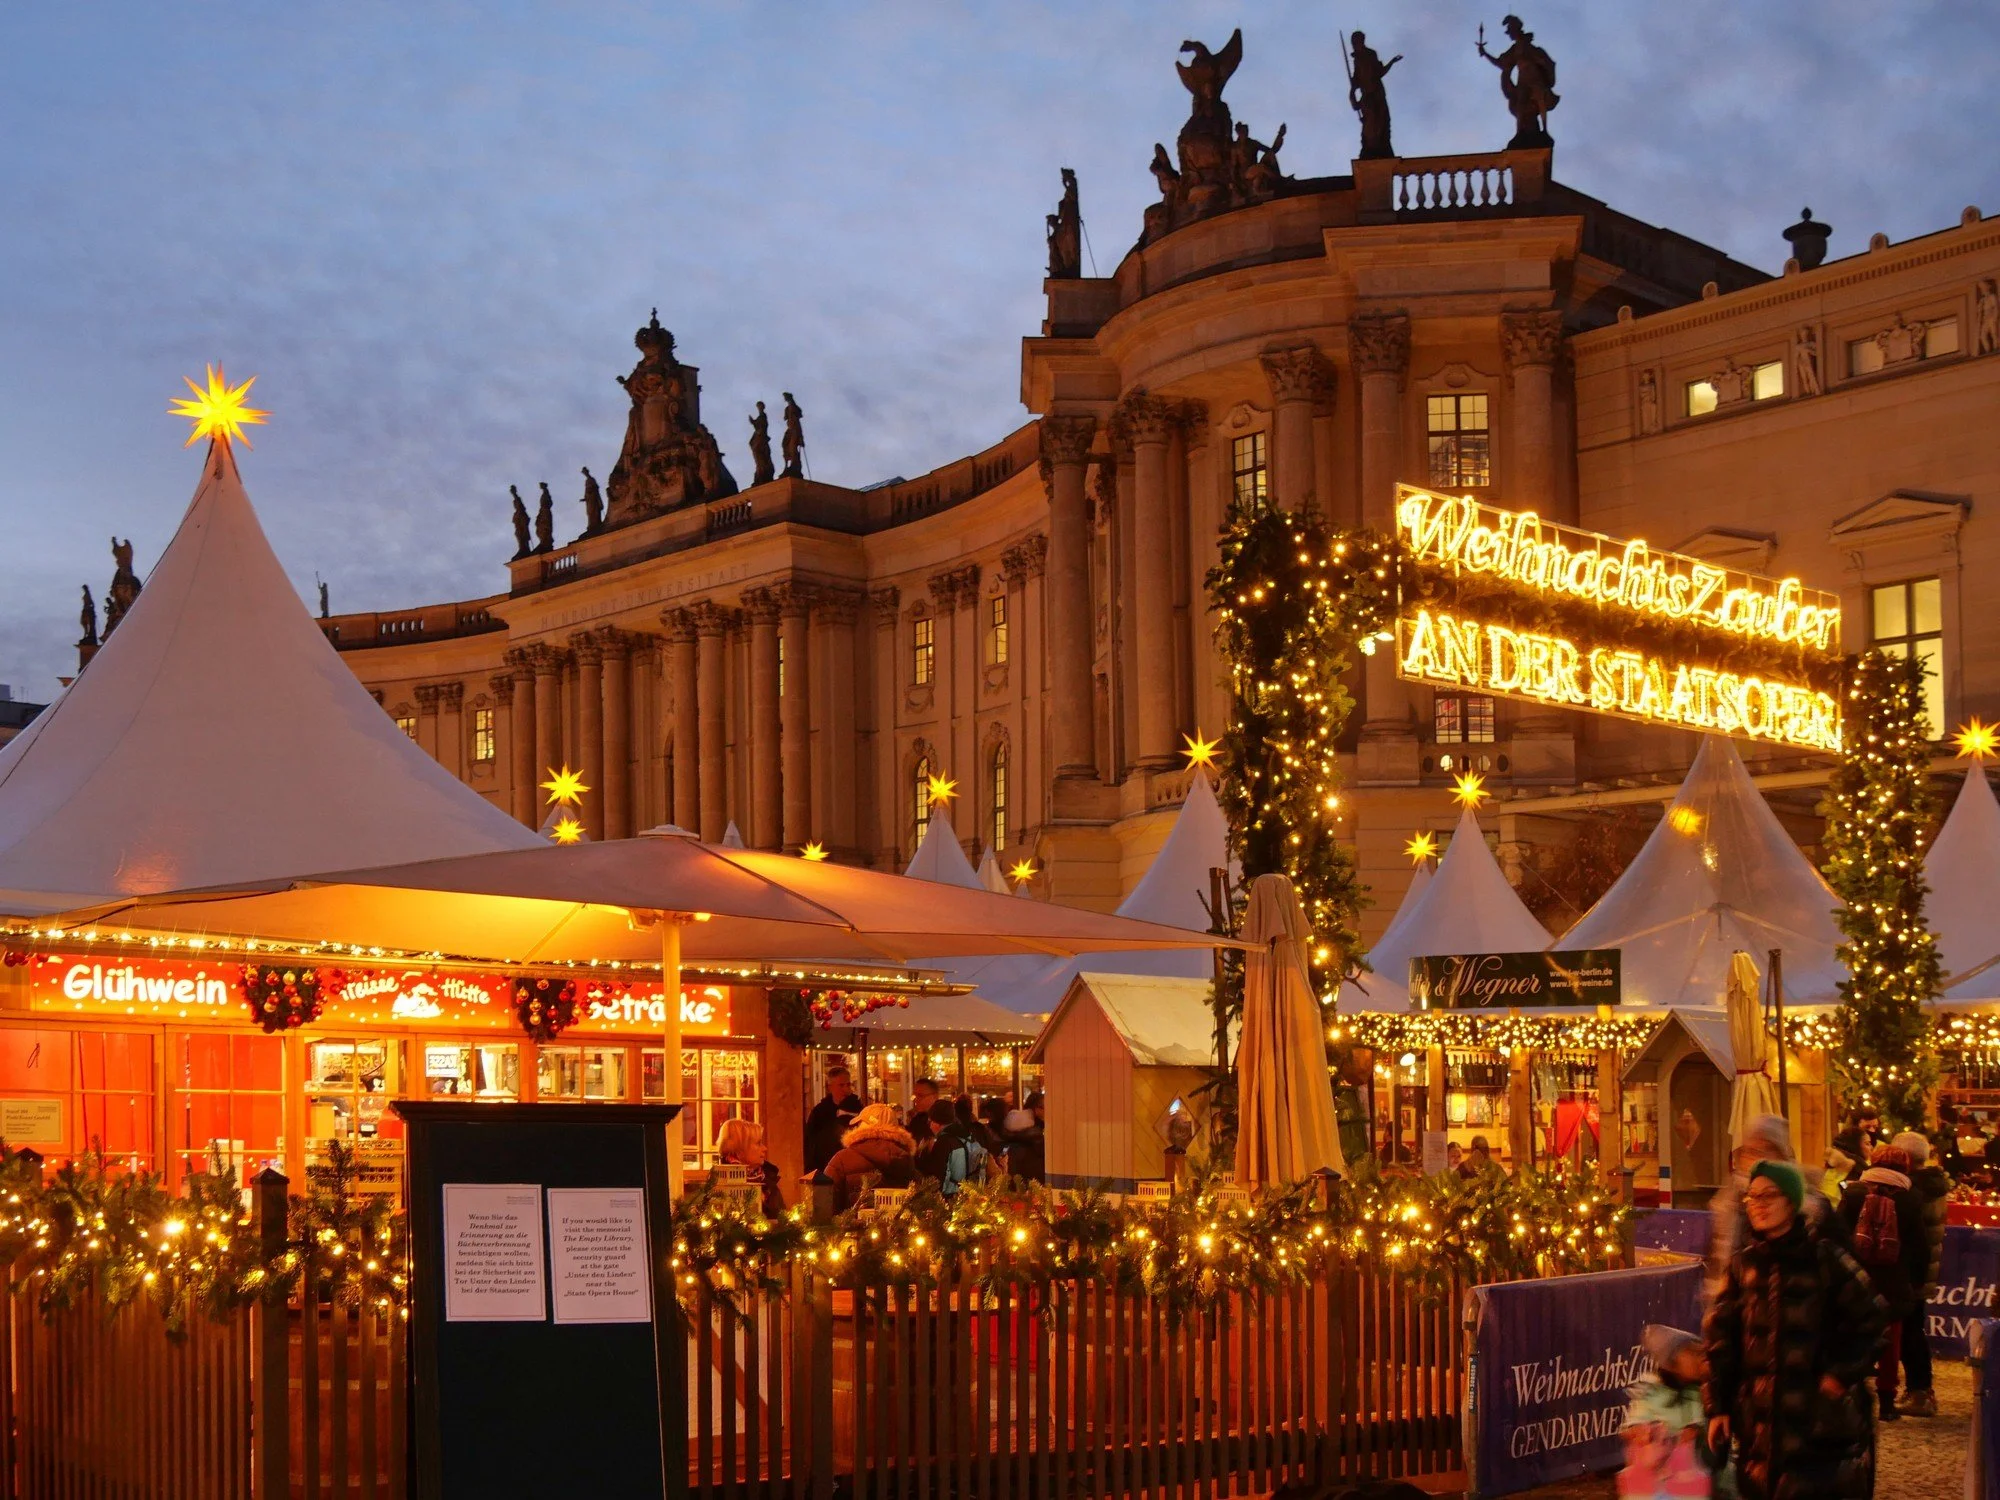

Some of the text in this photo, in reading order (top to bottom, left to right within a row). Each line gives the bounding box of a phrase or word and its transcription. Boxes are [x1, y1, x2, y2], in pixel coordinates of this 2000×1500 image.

[1400, 494, 1841, 650] WeihnachtsZauber
[1403, 610, 1842, 752] AN DER STAATSOPER
[64, 964, 227, 1005] Glühwein
[441, 977, 490, 1004] Hütte
[1434, 977, 1446, 997] &
[1443, 955, 1542, 1005] Wegner
[1549, 979, 1613, 988] www.l--weine.de
[587, 990, 712, 1023] Geträke
